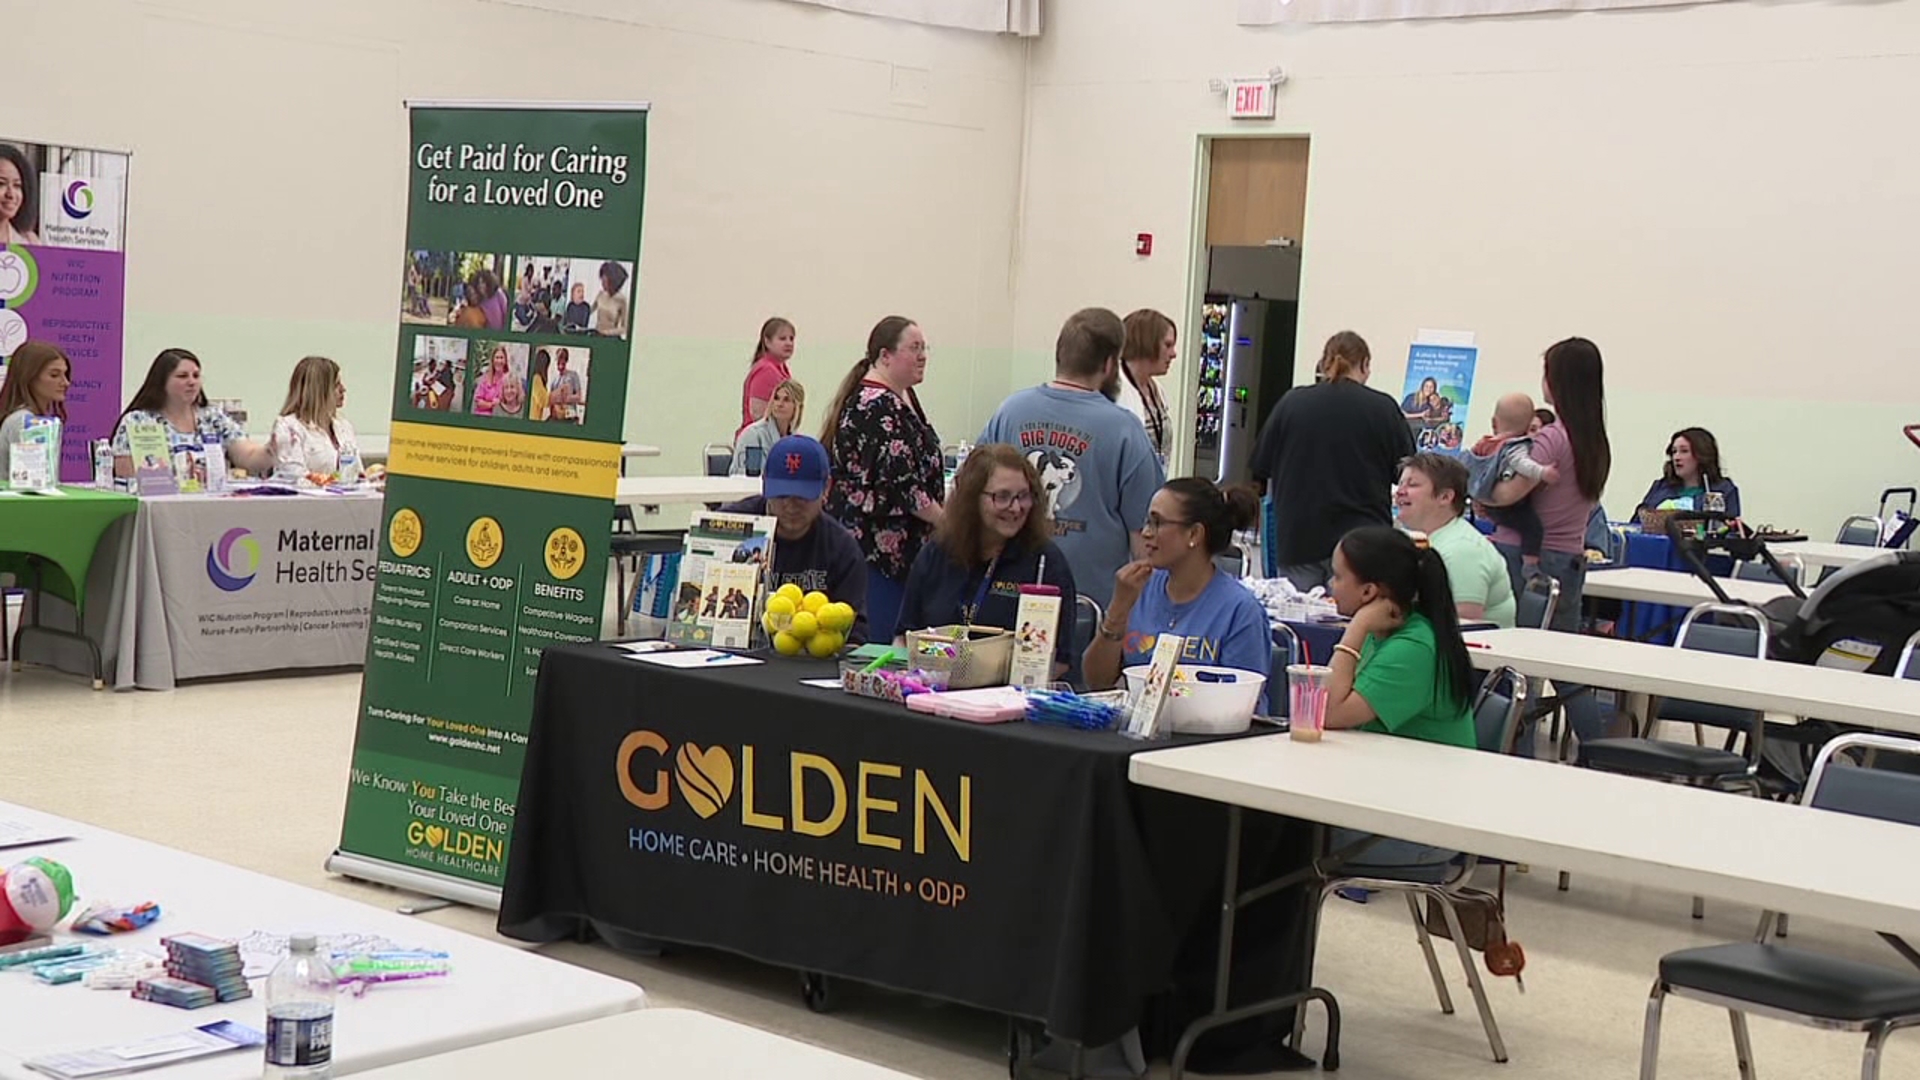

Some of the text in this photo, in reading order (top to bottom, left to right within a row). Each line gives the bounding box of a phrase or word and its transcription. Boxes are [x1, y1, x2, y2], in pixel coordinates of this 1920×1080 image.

[1236, 85, 1263, 113] EXIT
[417, 143, 627, 184] Get Paid for Caring
[428, 175, 604, 208] for a Loved One
[45, 224, 78, 233] Maternal
[85, 227, 109, 238] Family
[75, 236, 105, 246] Services
[51, 272, 101, 284] NUTRITION
[52, 286, 99, 298] PROGRAM
[42, 318, 112, 331] REPRODUCTIVE
[58, 333, 95, 344] HEALTH
[427, 441, 469, 453] Healthcare
[470, 446, 507, 457] empowers
[510, 449, 535, 460] families
[1020, 429, 1089, 457] BIG DOGS
[436, 455, 467, 467] services
[468, 458, 479, 467] for
[535, 467, 550, 476] and
[277, 529, 374, 553] Maternal
[276, 562, 347, 584] Health
[378, 560, 432, 579] PEDIATRICS
[447, 570, 514, 591] ADULT + ODP
[534, 583, 585, 602] BENEFITS
[404, 597, 431, 609] Program
[453, 595, 471, 606] Care
[481, 600, 501, 611] Home
[216, 613, 252, 621] Nutrition
[253, 611, 284, 621] Program
[290, 609, 338, 619] Reproductive
[396, 618, 422, 632] Nursing
[523, 605, 594, 625] Competitive Wages
[201, 620, 364, 636] Nurse-Family Partnership Cancer Screening
[438, 617, 508, 637] Companion Services
[519, 625, 553, 638] Healthcare
[400, 640, 421, 651] Home
[439, 641, 505, 661] Direct Care Workers
[1123, 630, 1220, 661] GOEN
[368, 706, 384, 718] Turn
[385, 708, 411, 724] Caring
[412, 714, 425, 724] For
[426, 716, 444, 728] Your
[445, 721, 469, 733] Loved
[470, 725, 486, 735] One
[487, 727, 503, 739] Into
[503, 733, 510, 742] A
[428, 732, 501, 755] www.goldenhc.net
[351, 769, 370, 786] We
[372, 772, 408, 793] Know
[411, 780, 436, 799] You
[438, 785, 468, 806] Take
[470, 792, 490, 811] the
[615, 729, 971, 863] GOLDEN
[407, 799, 507, 835] Your Loved One
[407, 820, 504, 864] GOLDEN
[405, 848, 500, 877] HOME HEALTHCARE
[629, 827, 967, 908] HOME CARE HOME HEALTH ODP
